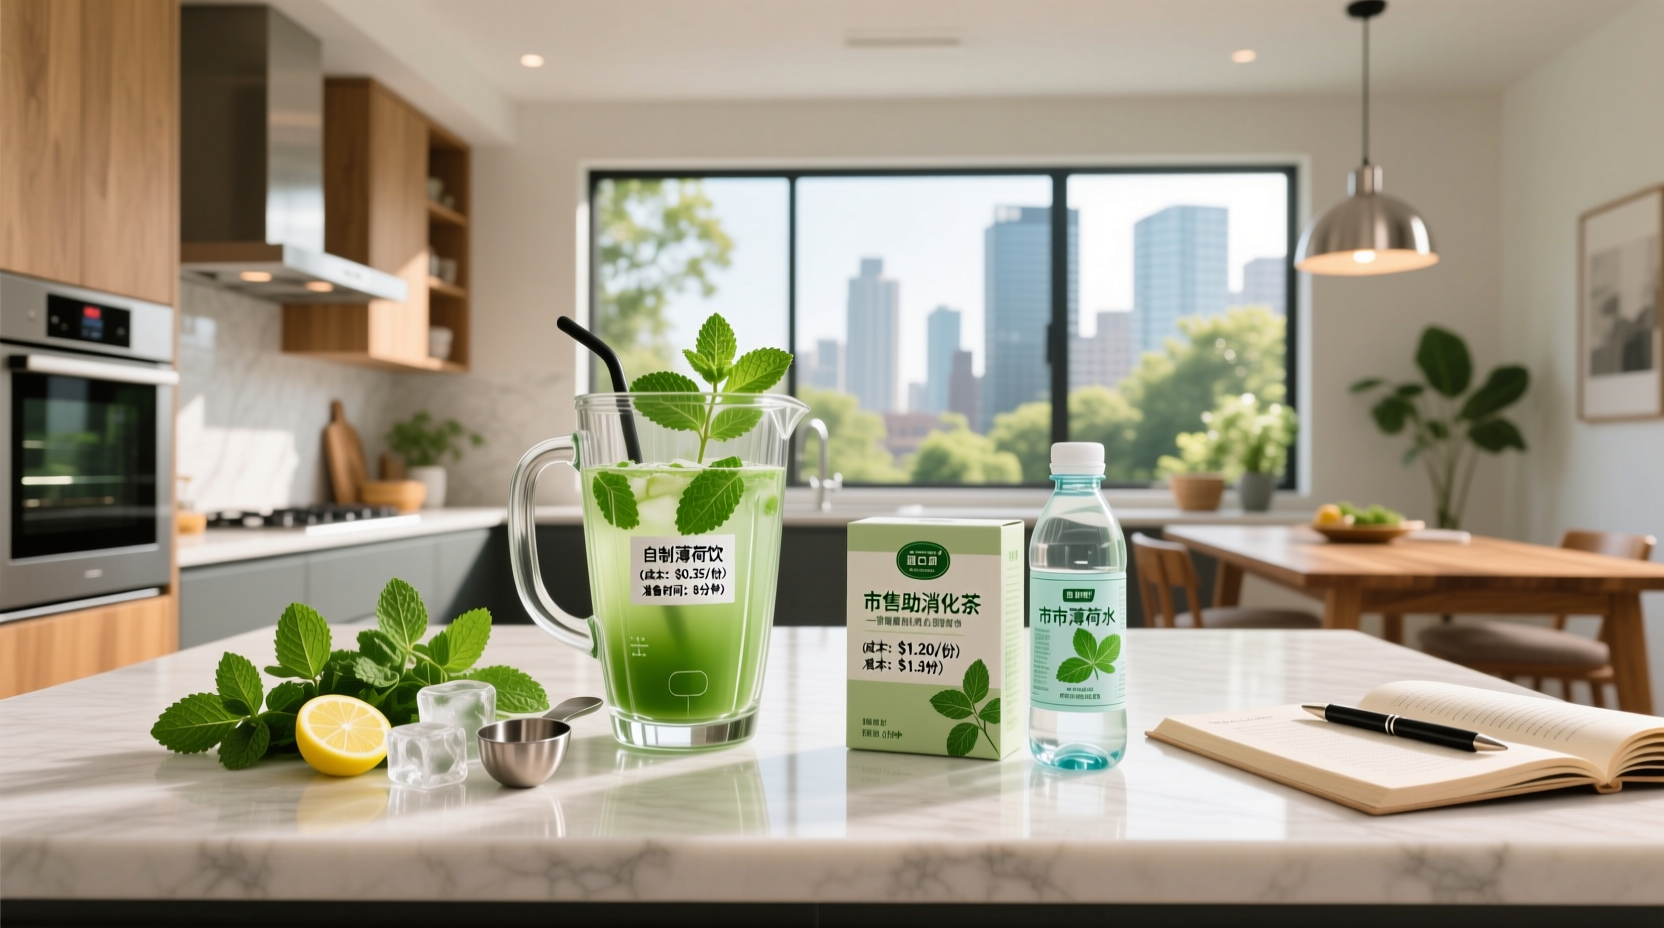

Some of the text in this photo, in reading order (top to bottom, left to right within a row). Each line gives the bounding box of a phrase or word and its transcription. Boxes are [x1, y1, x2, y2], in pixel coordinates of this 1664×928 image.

[644, 545, 724, 563] 自制薄荷饮
[863, 590, 982, 615] 市售助消化茶
[1039, 605, 1116, 627] 市市薄荷水
